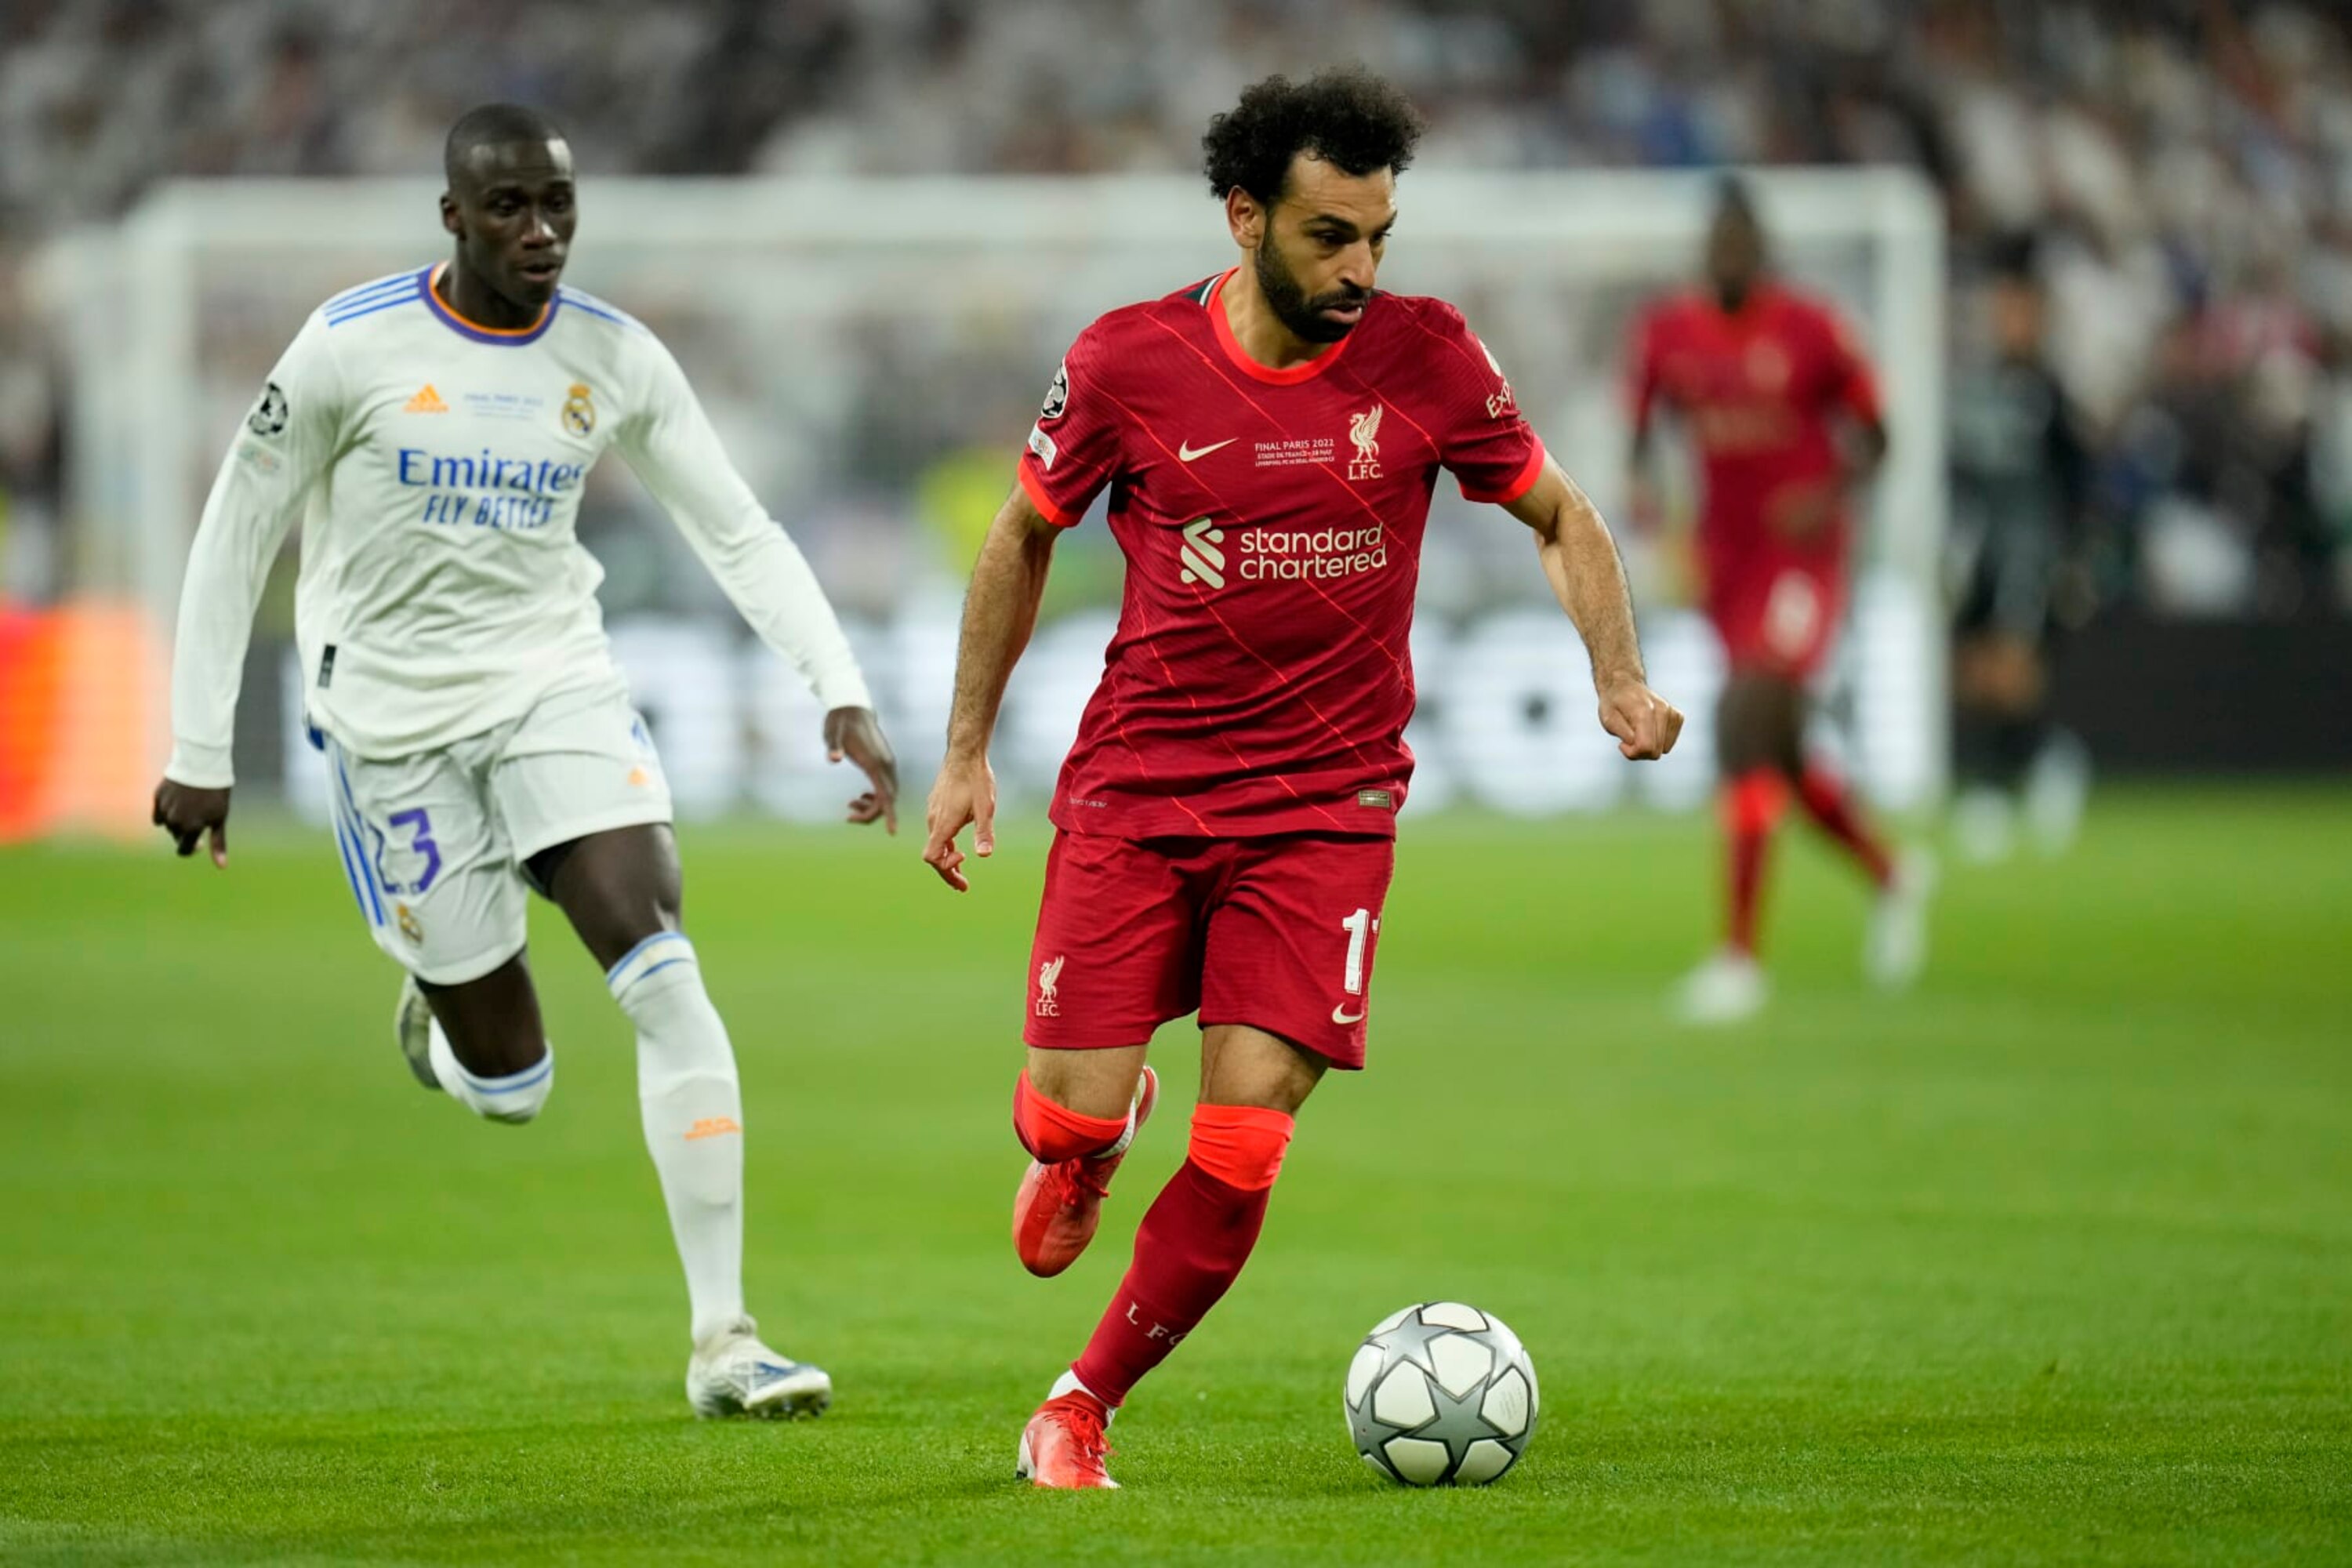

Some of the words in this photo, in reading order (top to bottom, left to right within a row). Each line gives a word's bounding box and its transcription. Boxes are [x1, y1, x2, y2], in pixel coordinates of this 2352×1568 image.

[1254, 441, 1281, 452] FINAL
[1283, 440, 1310, 450] PARIS
[1312, 438, 1335, 448] 2022
[423, 495, 469, 524] FLY
[1240, 522, 1383, 554] standard
[1240, 544, 1387, 579] chartered
